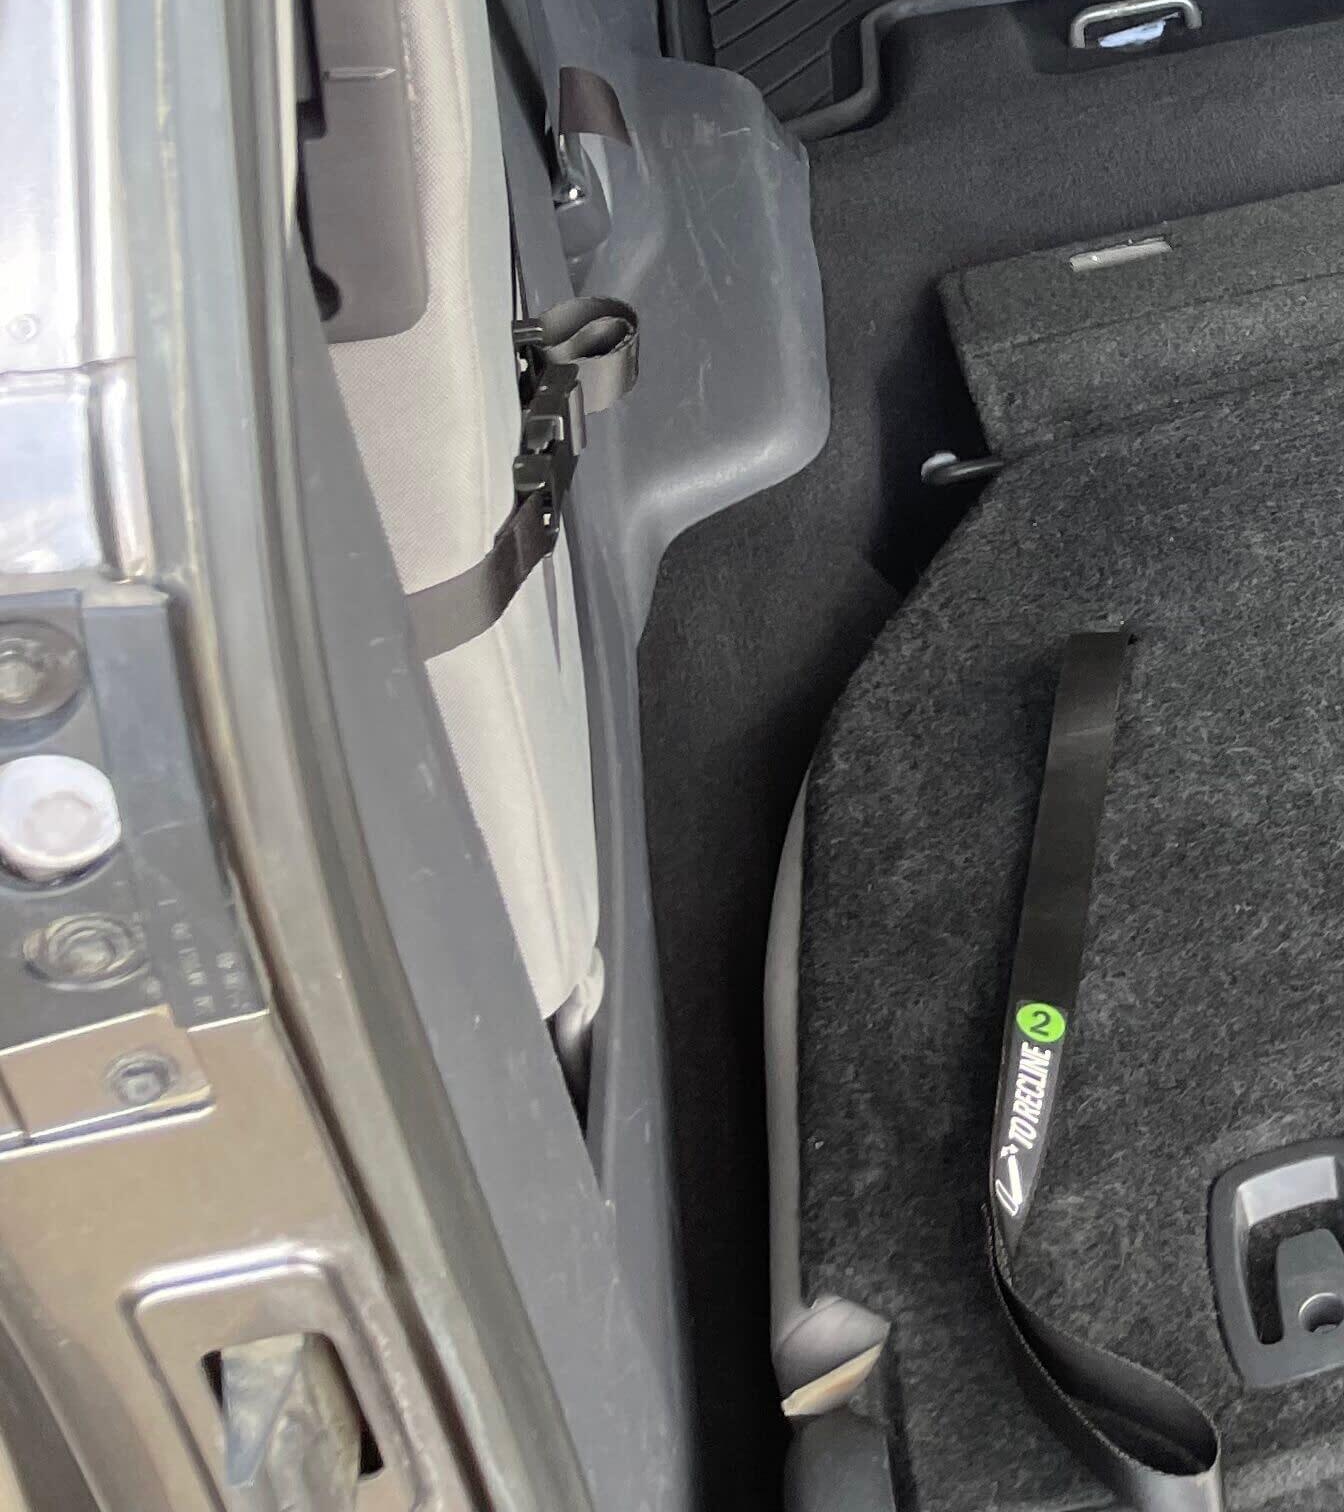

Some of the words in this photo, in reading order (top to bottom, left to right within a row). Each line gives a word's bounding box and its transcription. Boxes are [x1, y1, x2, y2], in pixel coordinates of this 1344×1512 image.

[1030, 1010, 1051, 1037] 2
[1013, 1041, 1052, 1125] RECLINE
[1008, 1116, 1038, 1150] TO
